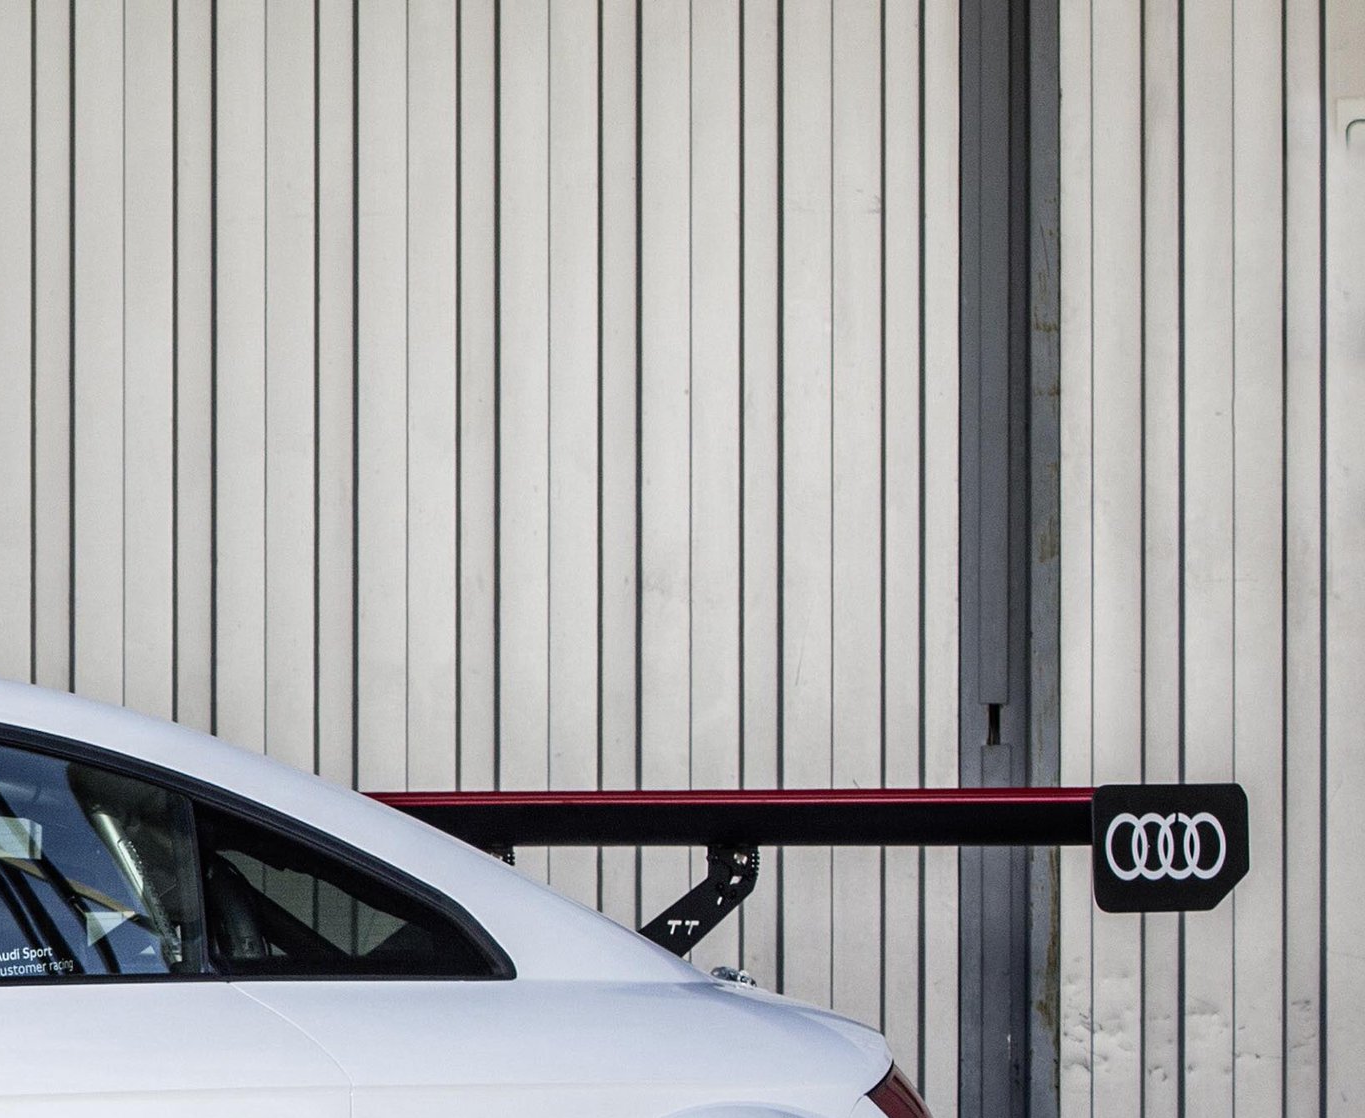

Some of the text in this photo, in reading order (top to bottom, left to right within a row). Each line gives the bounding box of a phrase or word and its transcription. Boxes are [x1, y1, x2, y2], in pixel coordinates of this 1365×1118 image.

[667, 920, 700, 935] TT
[22, 946, 53, 961] Sport
[49, 958, 74, 972] racing
